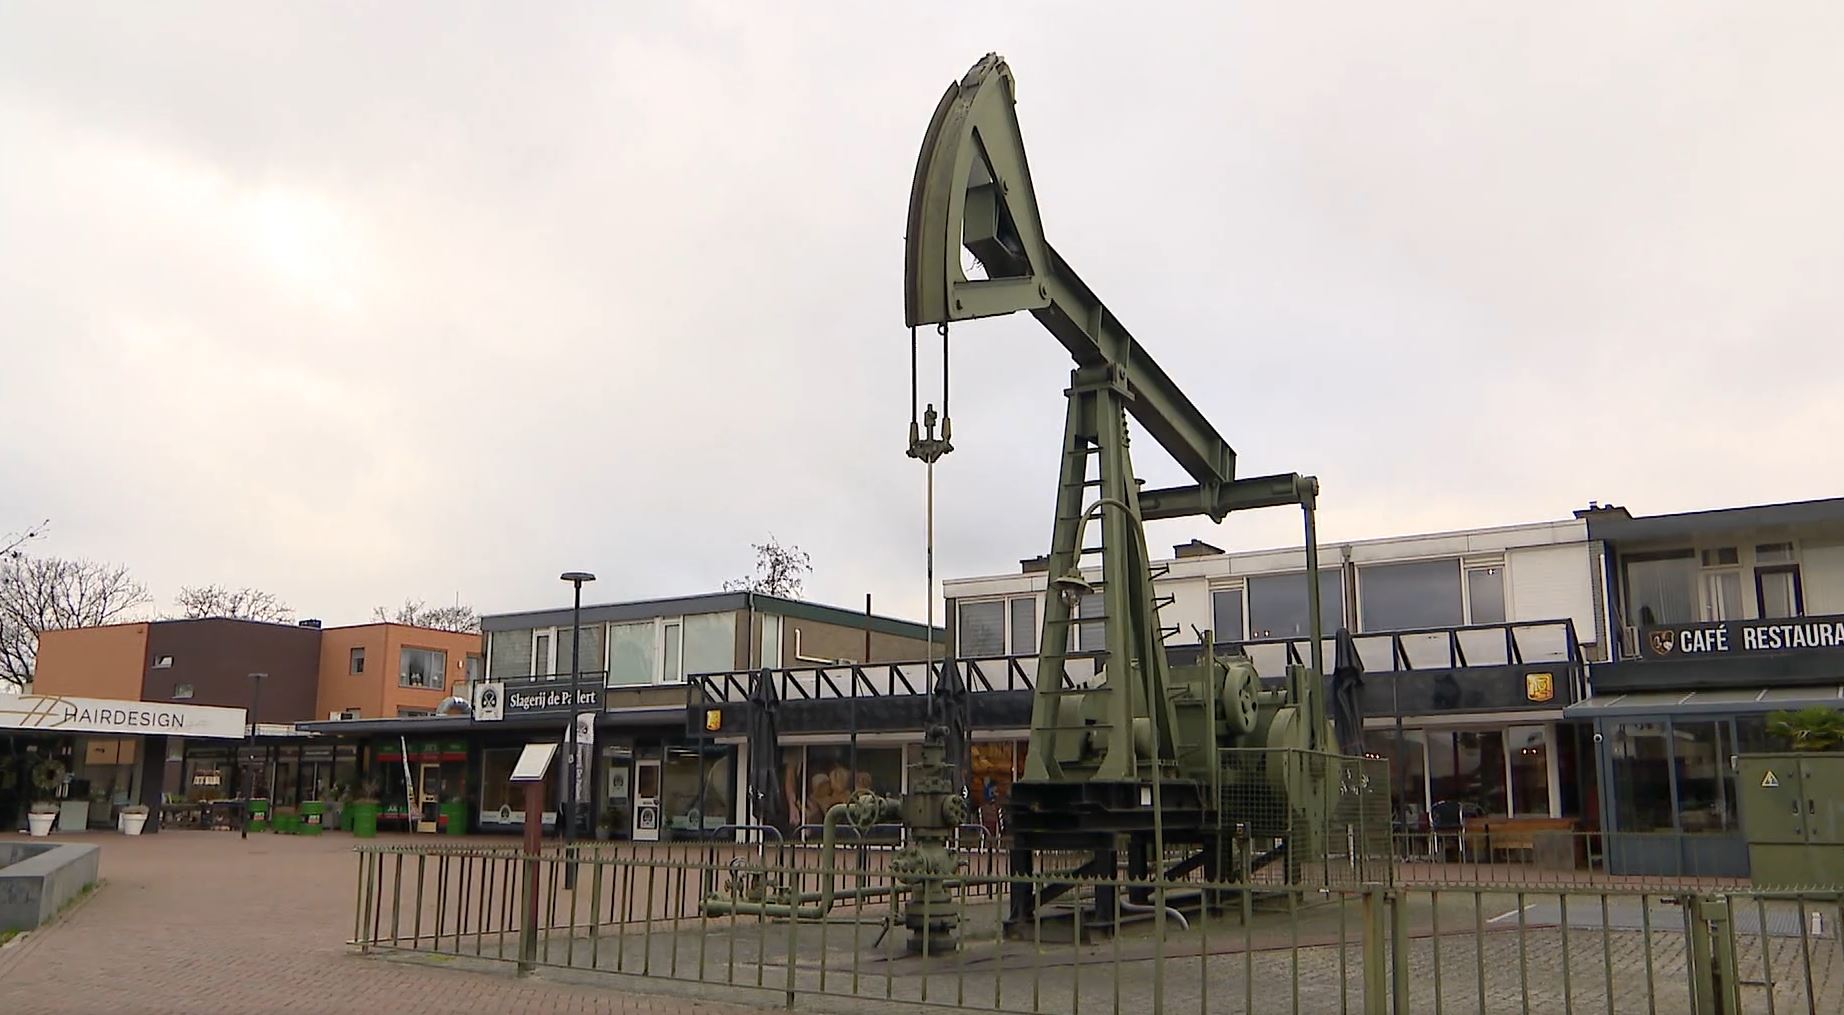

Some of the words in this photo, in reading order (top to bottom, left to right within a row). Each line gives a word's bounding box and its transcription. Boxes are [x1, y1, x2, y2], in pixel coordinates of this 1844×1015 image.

[1680, 624, 1729, 653] CAFÉ
[1743, 623, 1844, 650] RESTAURA
[510, 691, 546, 710] Slagerij
[547, 691, 560, 705] de
[64, 707, 185, 728] HAIRDESIGN
